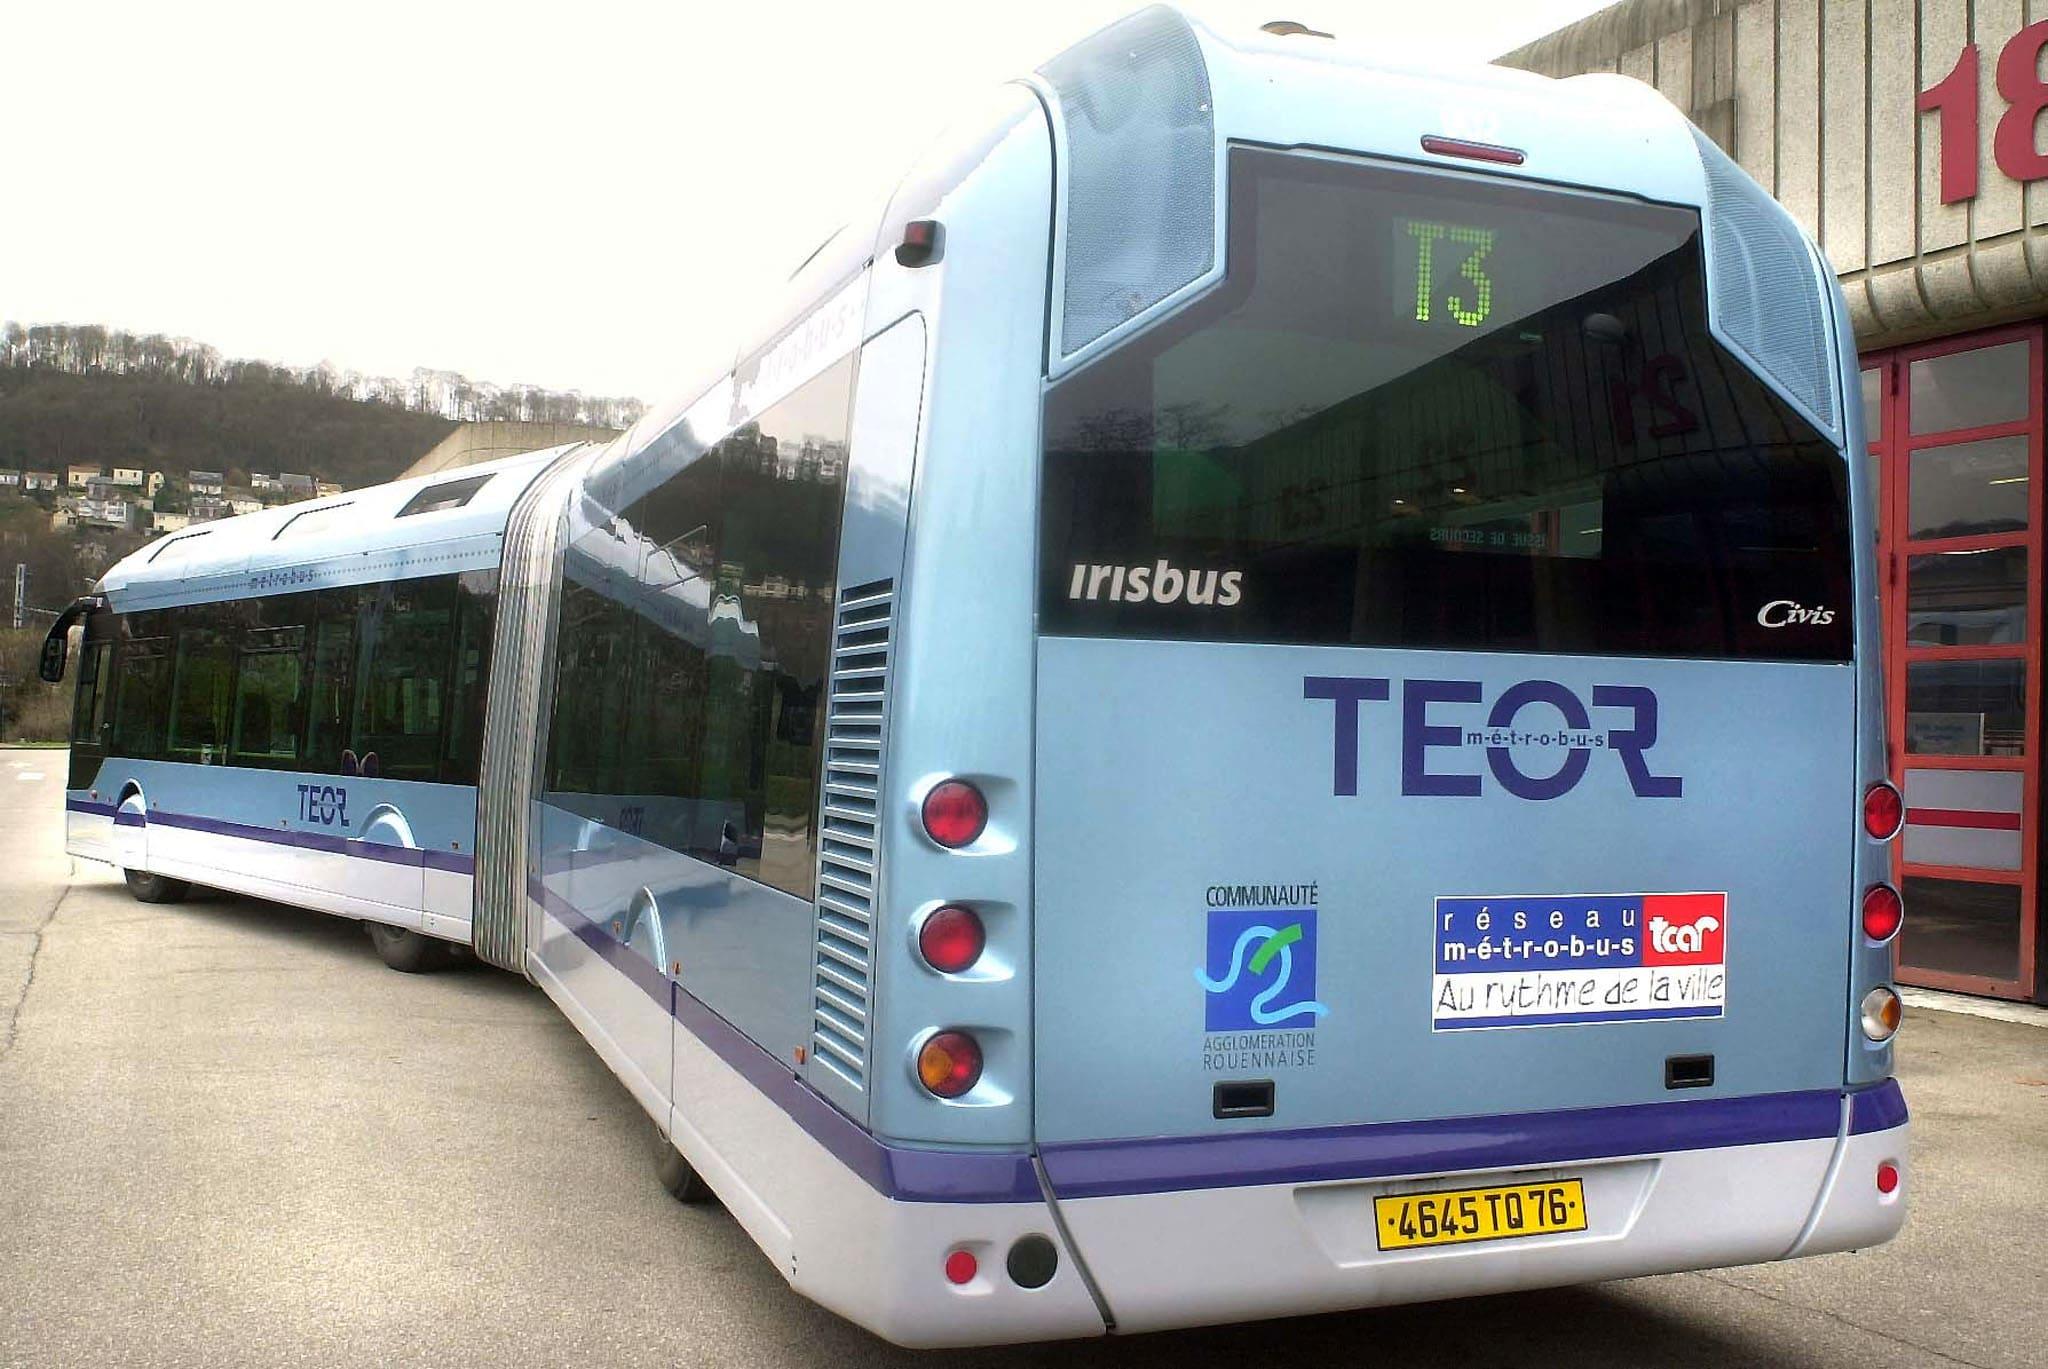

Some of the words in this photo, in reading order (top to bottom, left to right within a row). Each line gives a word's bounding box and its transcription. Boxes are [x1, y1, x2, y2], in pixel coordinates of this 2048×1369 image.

[1408, 222, 1492, 326] T3
[1069, 559, 1243, 606] irisbus
[1757, 600, 1836, 628] Civis
[1303, 676, 1683, 800] TEOR
[297, 784, 350, 827] TEOR
[1206, 881, 1319, 907] COMMUNAUTÉ
[1648, 916, 1720, 953] tcar
[1437, 977, 1475, 1012] Au
[1485, 972, 1596, 1017] rythme
[1604, 973, 1639, 1005] de
[1649, 969, 1671, 1001] la
[1677, 967, 1724, 1001] ville
[1203, 1049, 1316, 1071] ROUENNAISE
